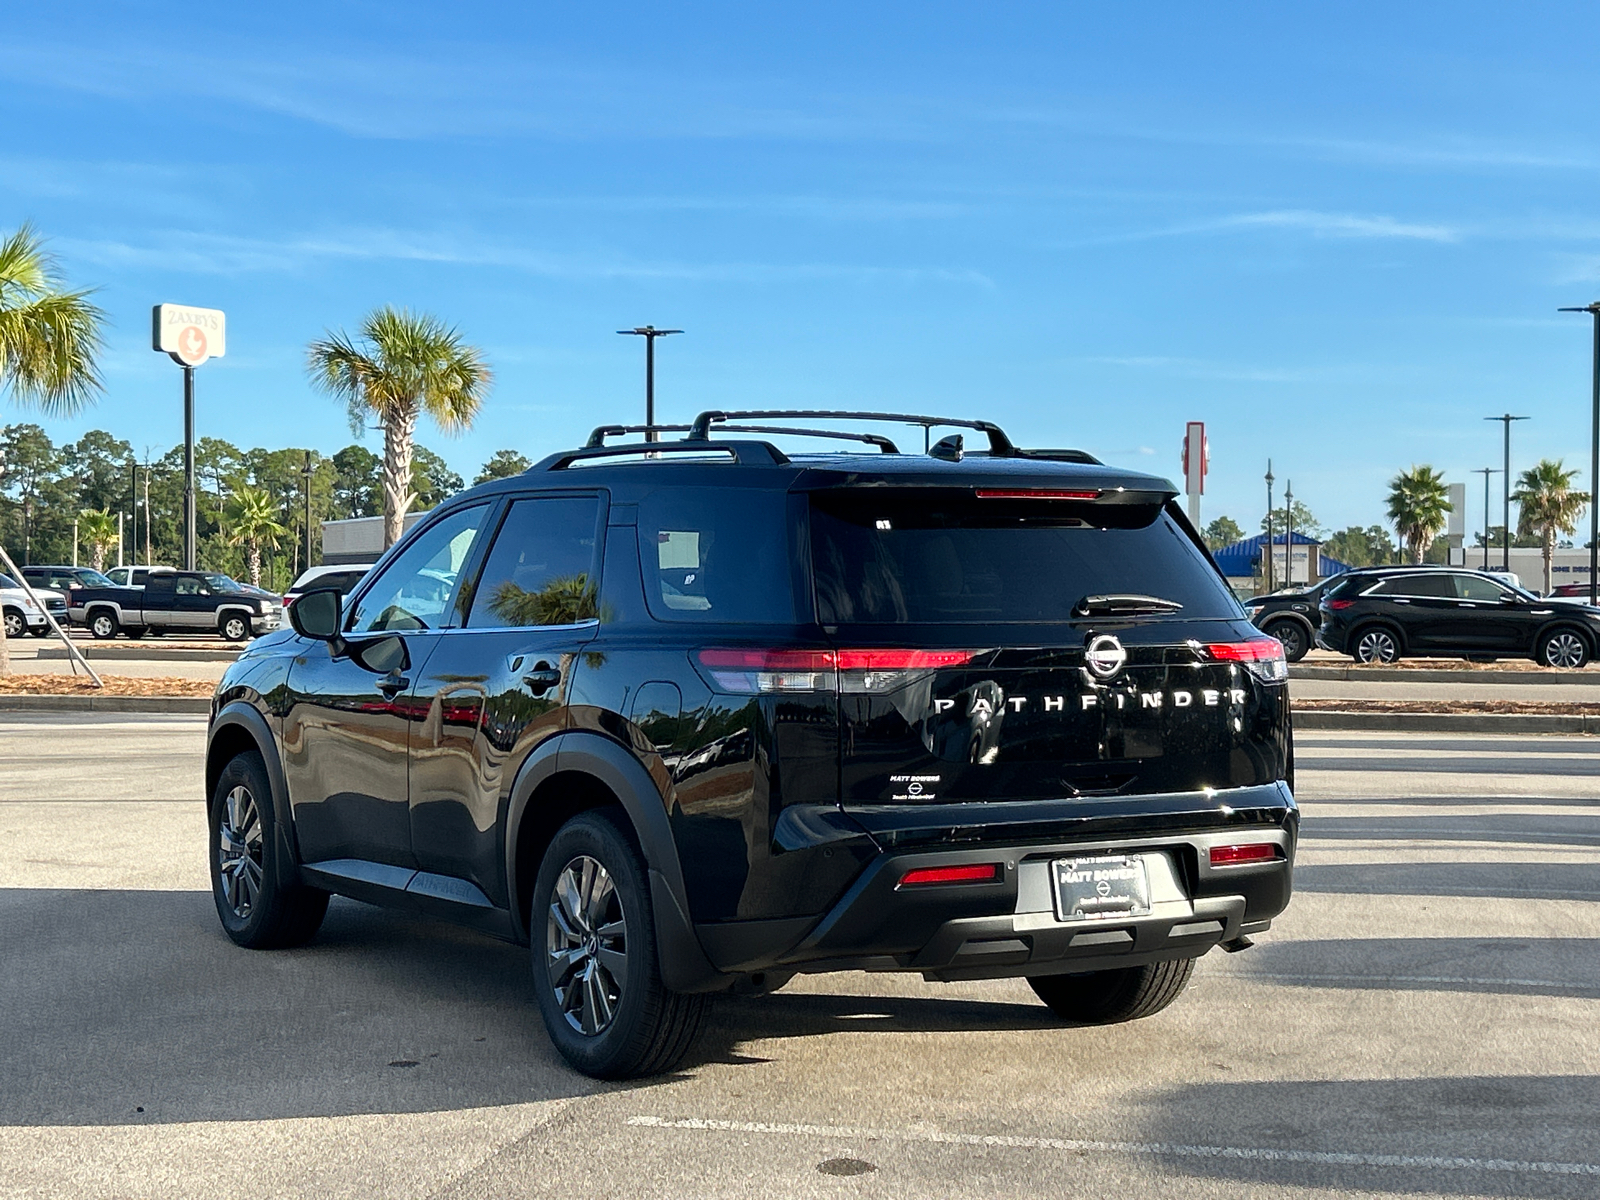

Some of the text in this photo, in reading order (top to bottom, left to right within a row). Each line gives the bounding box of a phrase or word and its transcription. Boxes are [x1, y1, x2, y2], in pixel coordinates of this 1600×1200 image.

[168, 310, 218, 330] ZAXBY'S
[934, 689, 1245, 715] PATHFINDER
[1061, 871, 1093, 883] MATT
